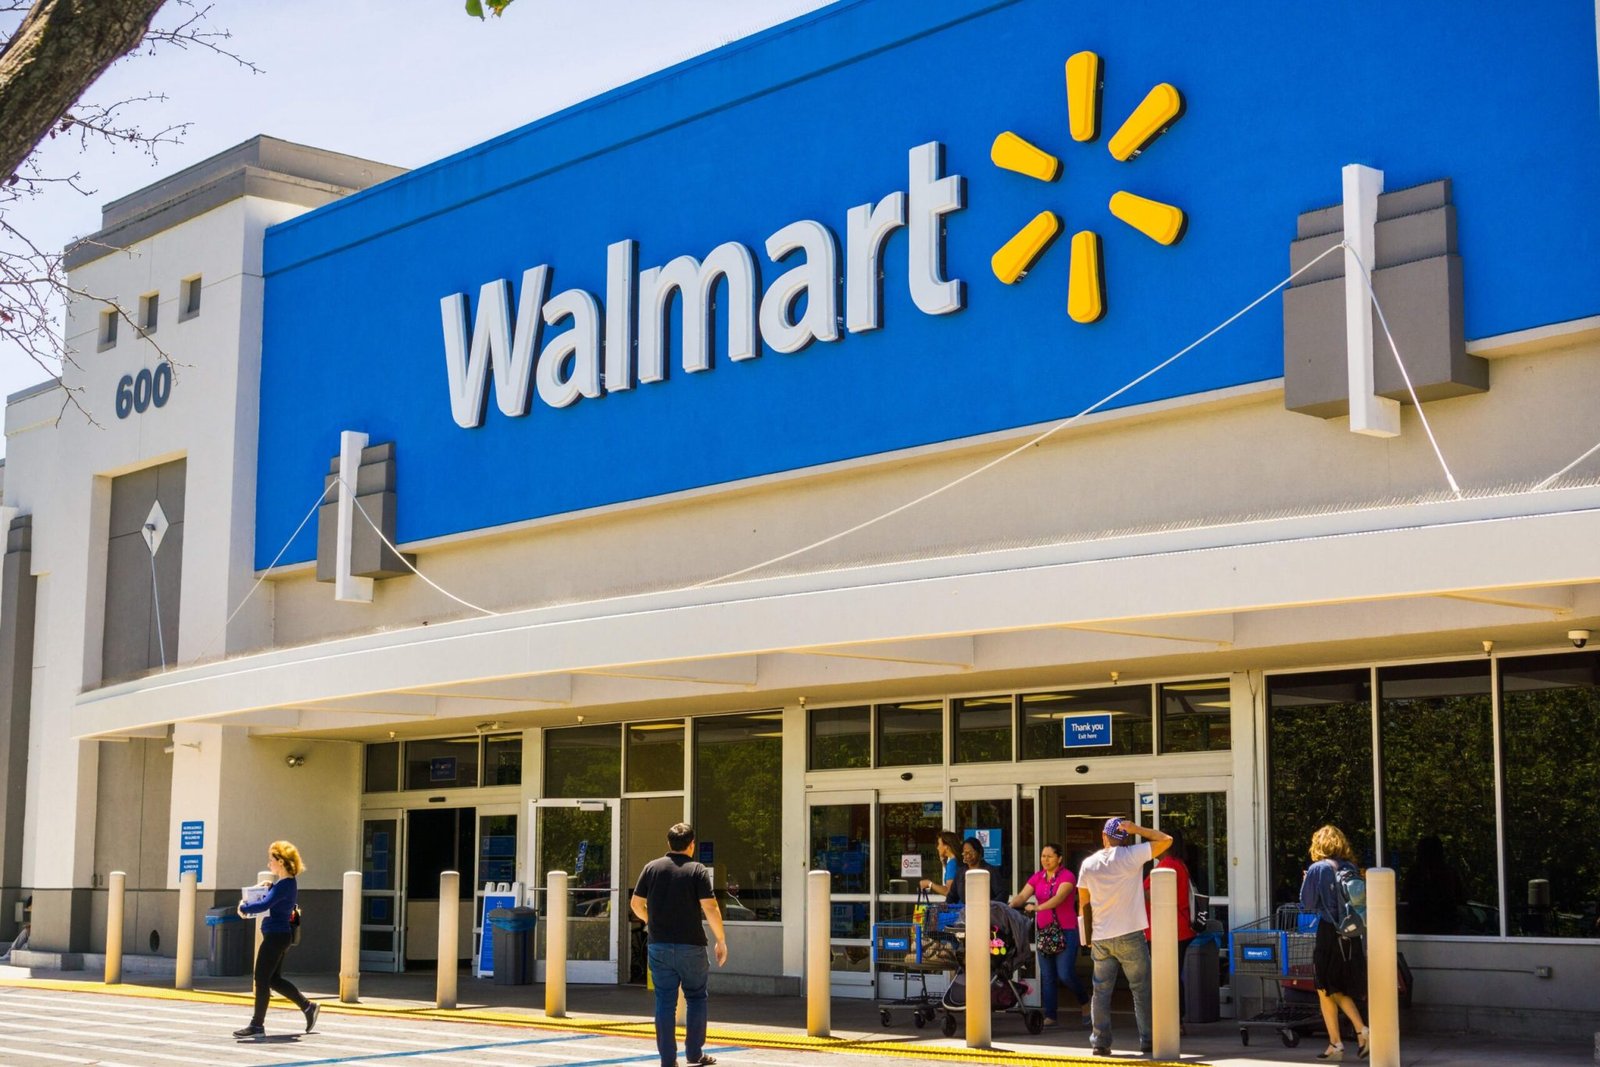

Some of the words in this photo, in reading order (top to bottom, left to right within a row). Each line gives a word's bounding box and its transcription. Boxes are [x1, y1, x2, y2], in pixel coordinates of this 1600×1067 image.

[439, 140, 967, 429] Walmart
[115, 362, 172, 419] 600
[1071, 722, 1091, 732] Thank
[1092, 723, 1104, 733] you
